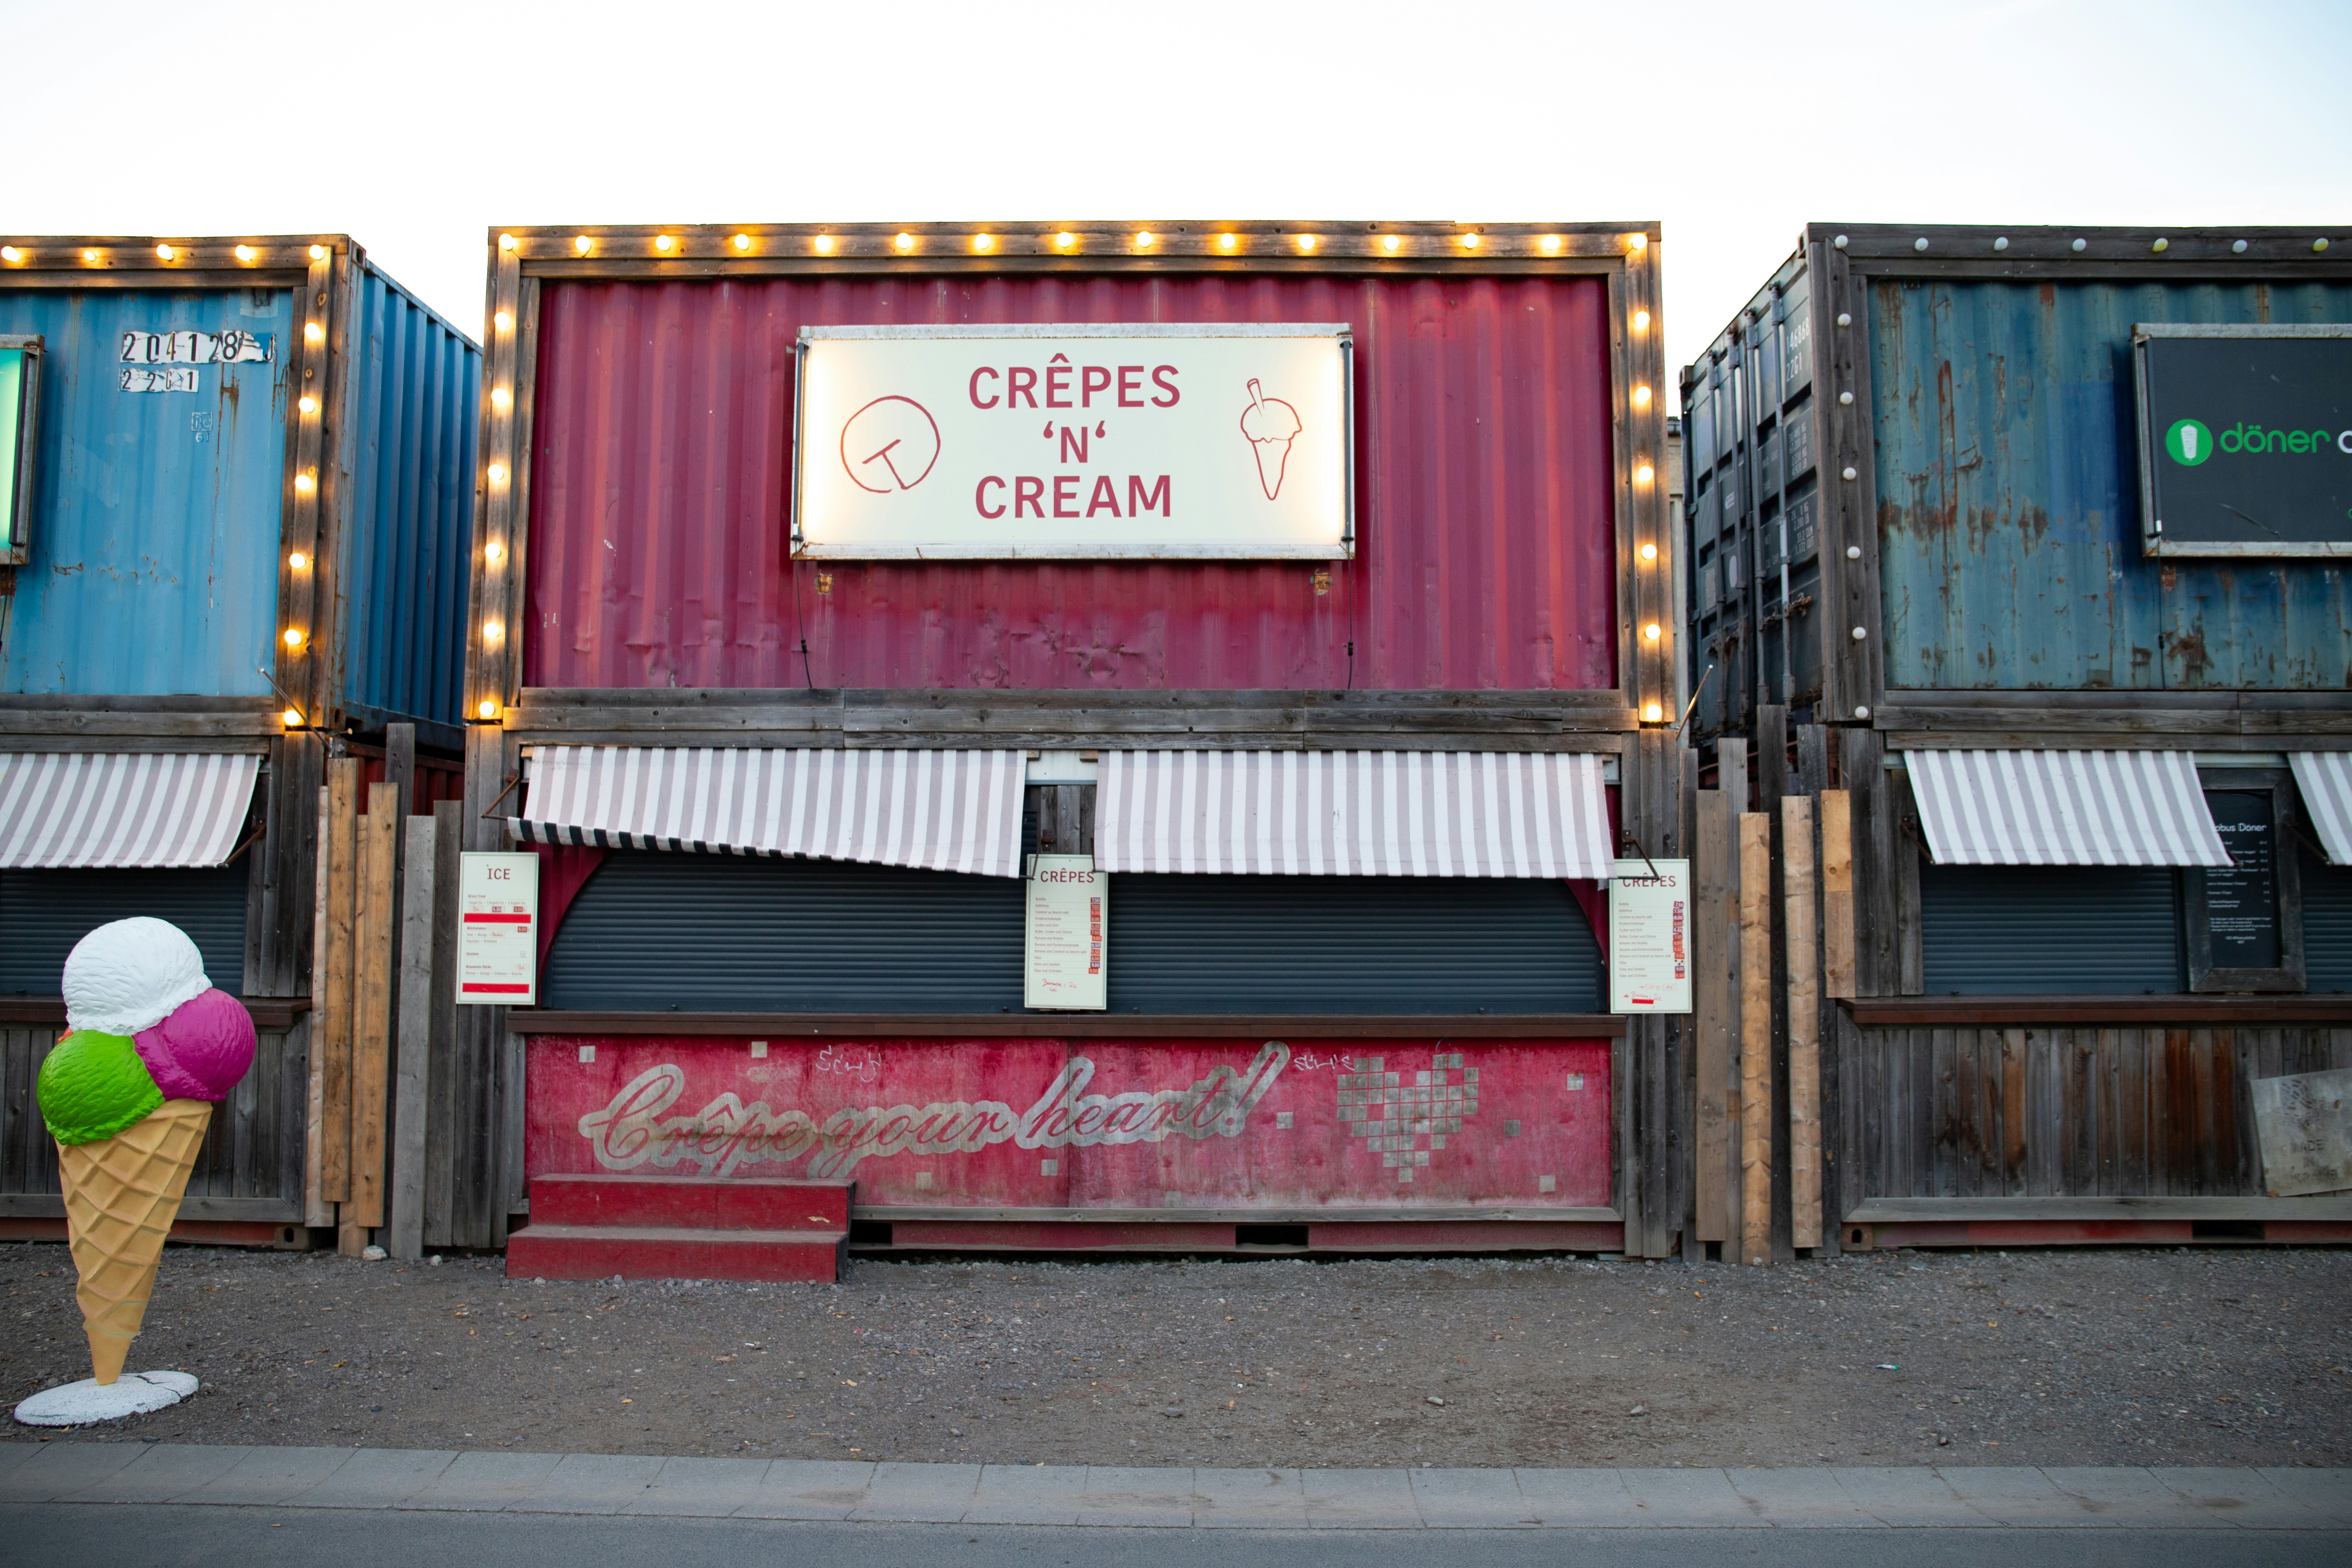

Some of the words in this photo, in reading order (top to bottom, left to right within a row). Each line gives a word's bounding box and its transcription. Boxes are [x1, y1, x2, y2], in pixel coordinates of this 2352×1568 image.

[969, 353, 1181, 409] CRÊPES
[2220, 421, 2331, 453] döner
[975, 475, 1171, 519] CREAM
[488, 868, 511, 880] ICE
[1040, 867, 1095, 883] CRÊPES
[811, 1104, 1015, 1176] your
[1021, 1044, 1288, 1143] heart!
